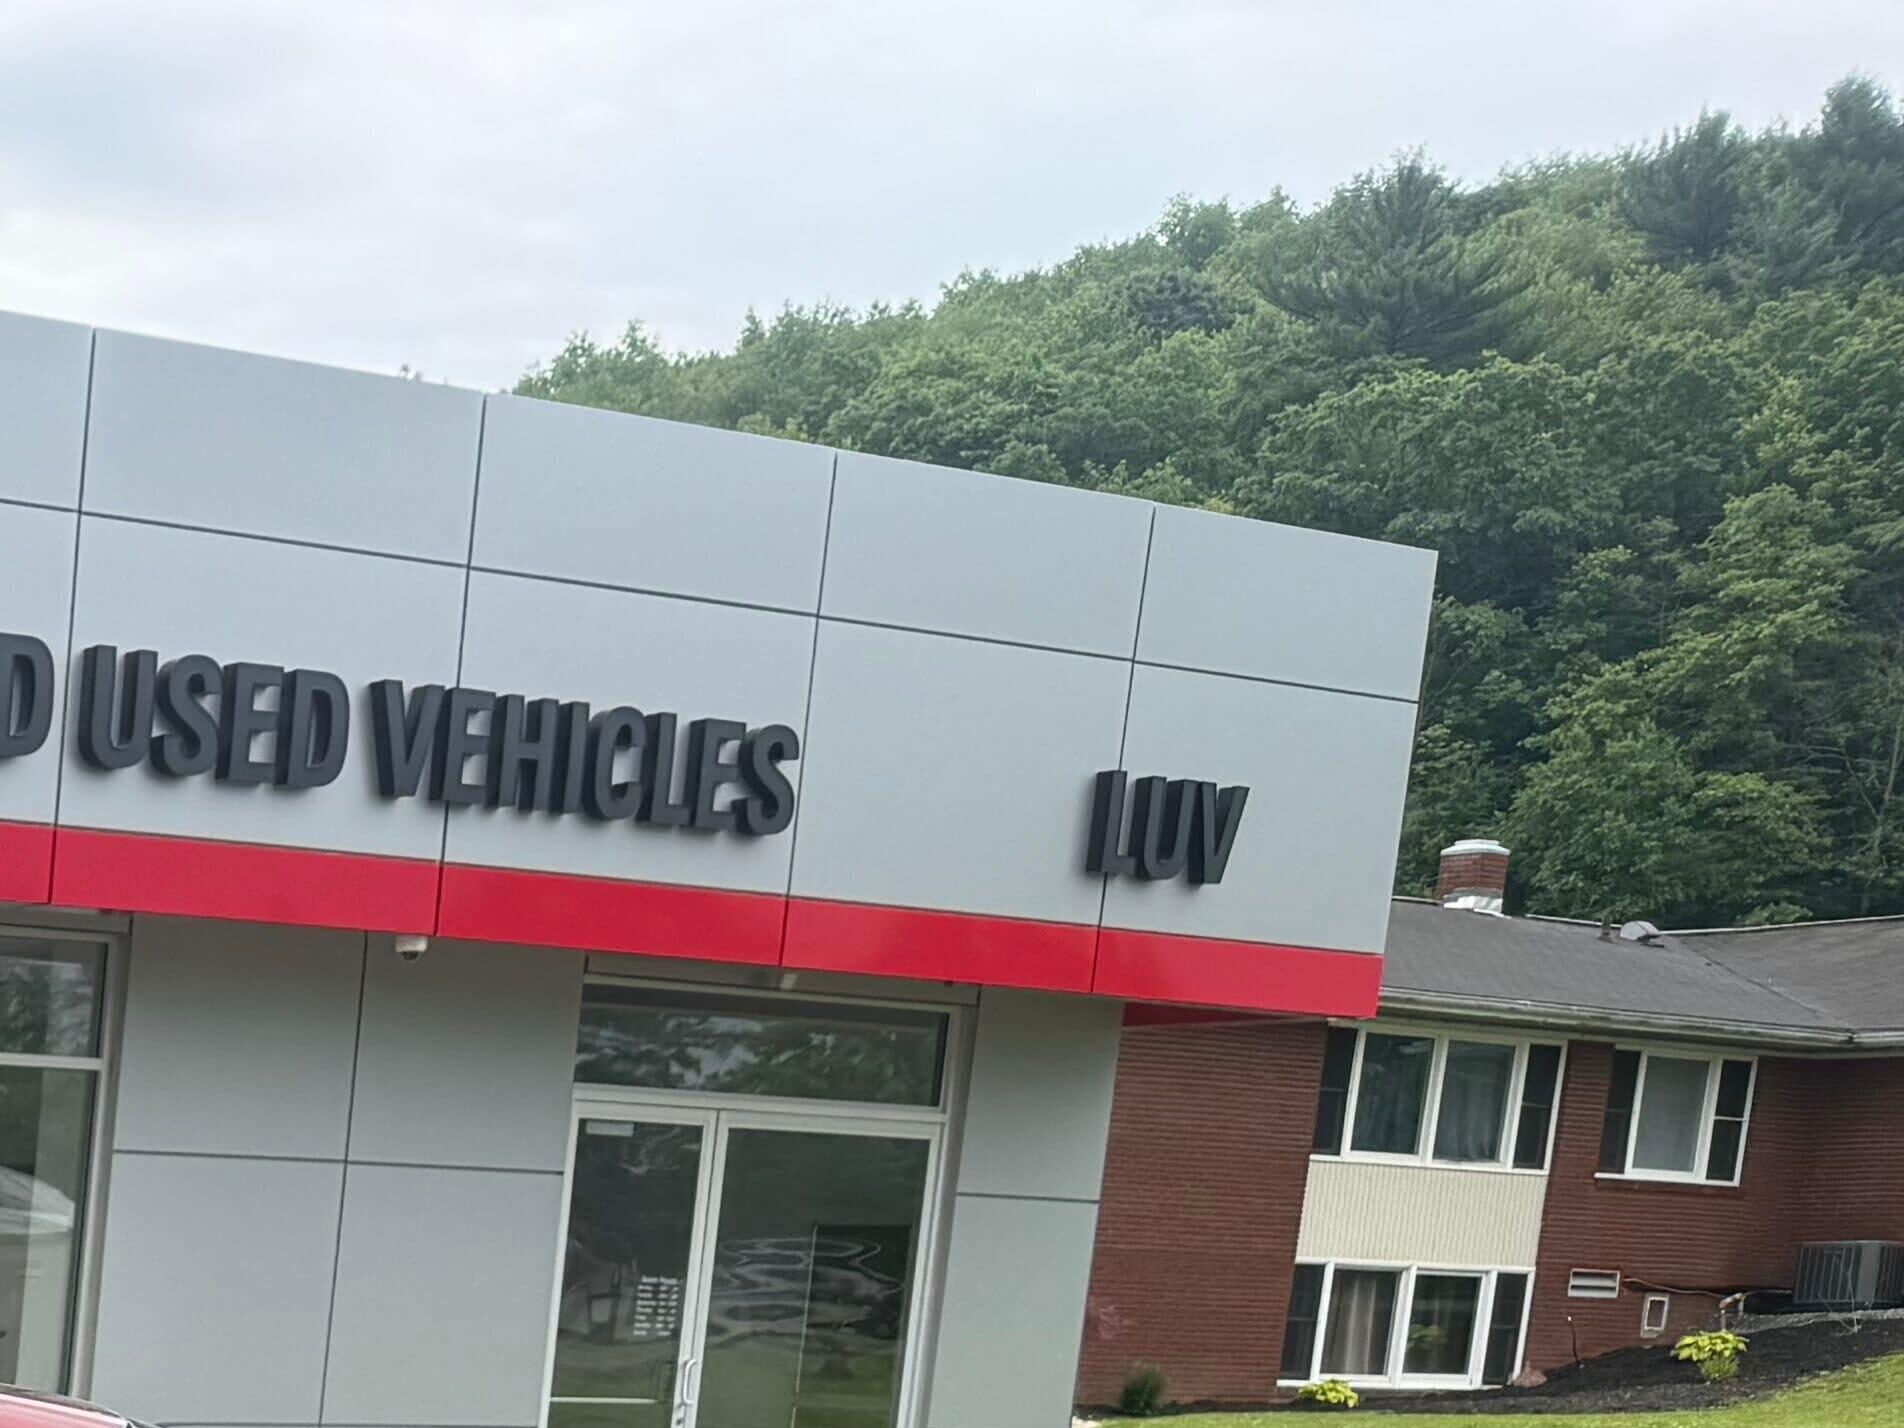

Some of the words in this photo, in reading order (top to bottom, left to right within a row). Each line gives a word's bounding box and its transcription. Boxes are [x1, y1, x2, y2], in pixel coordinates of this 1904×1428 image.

[77, 644, 351, 788] USED
[368, 678, 800, 837] VEHICLES
[1085, 769, 1251, 885] LUV
